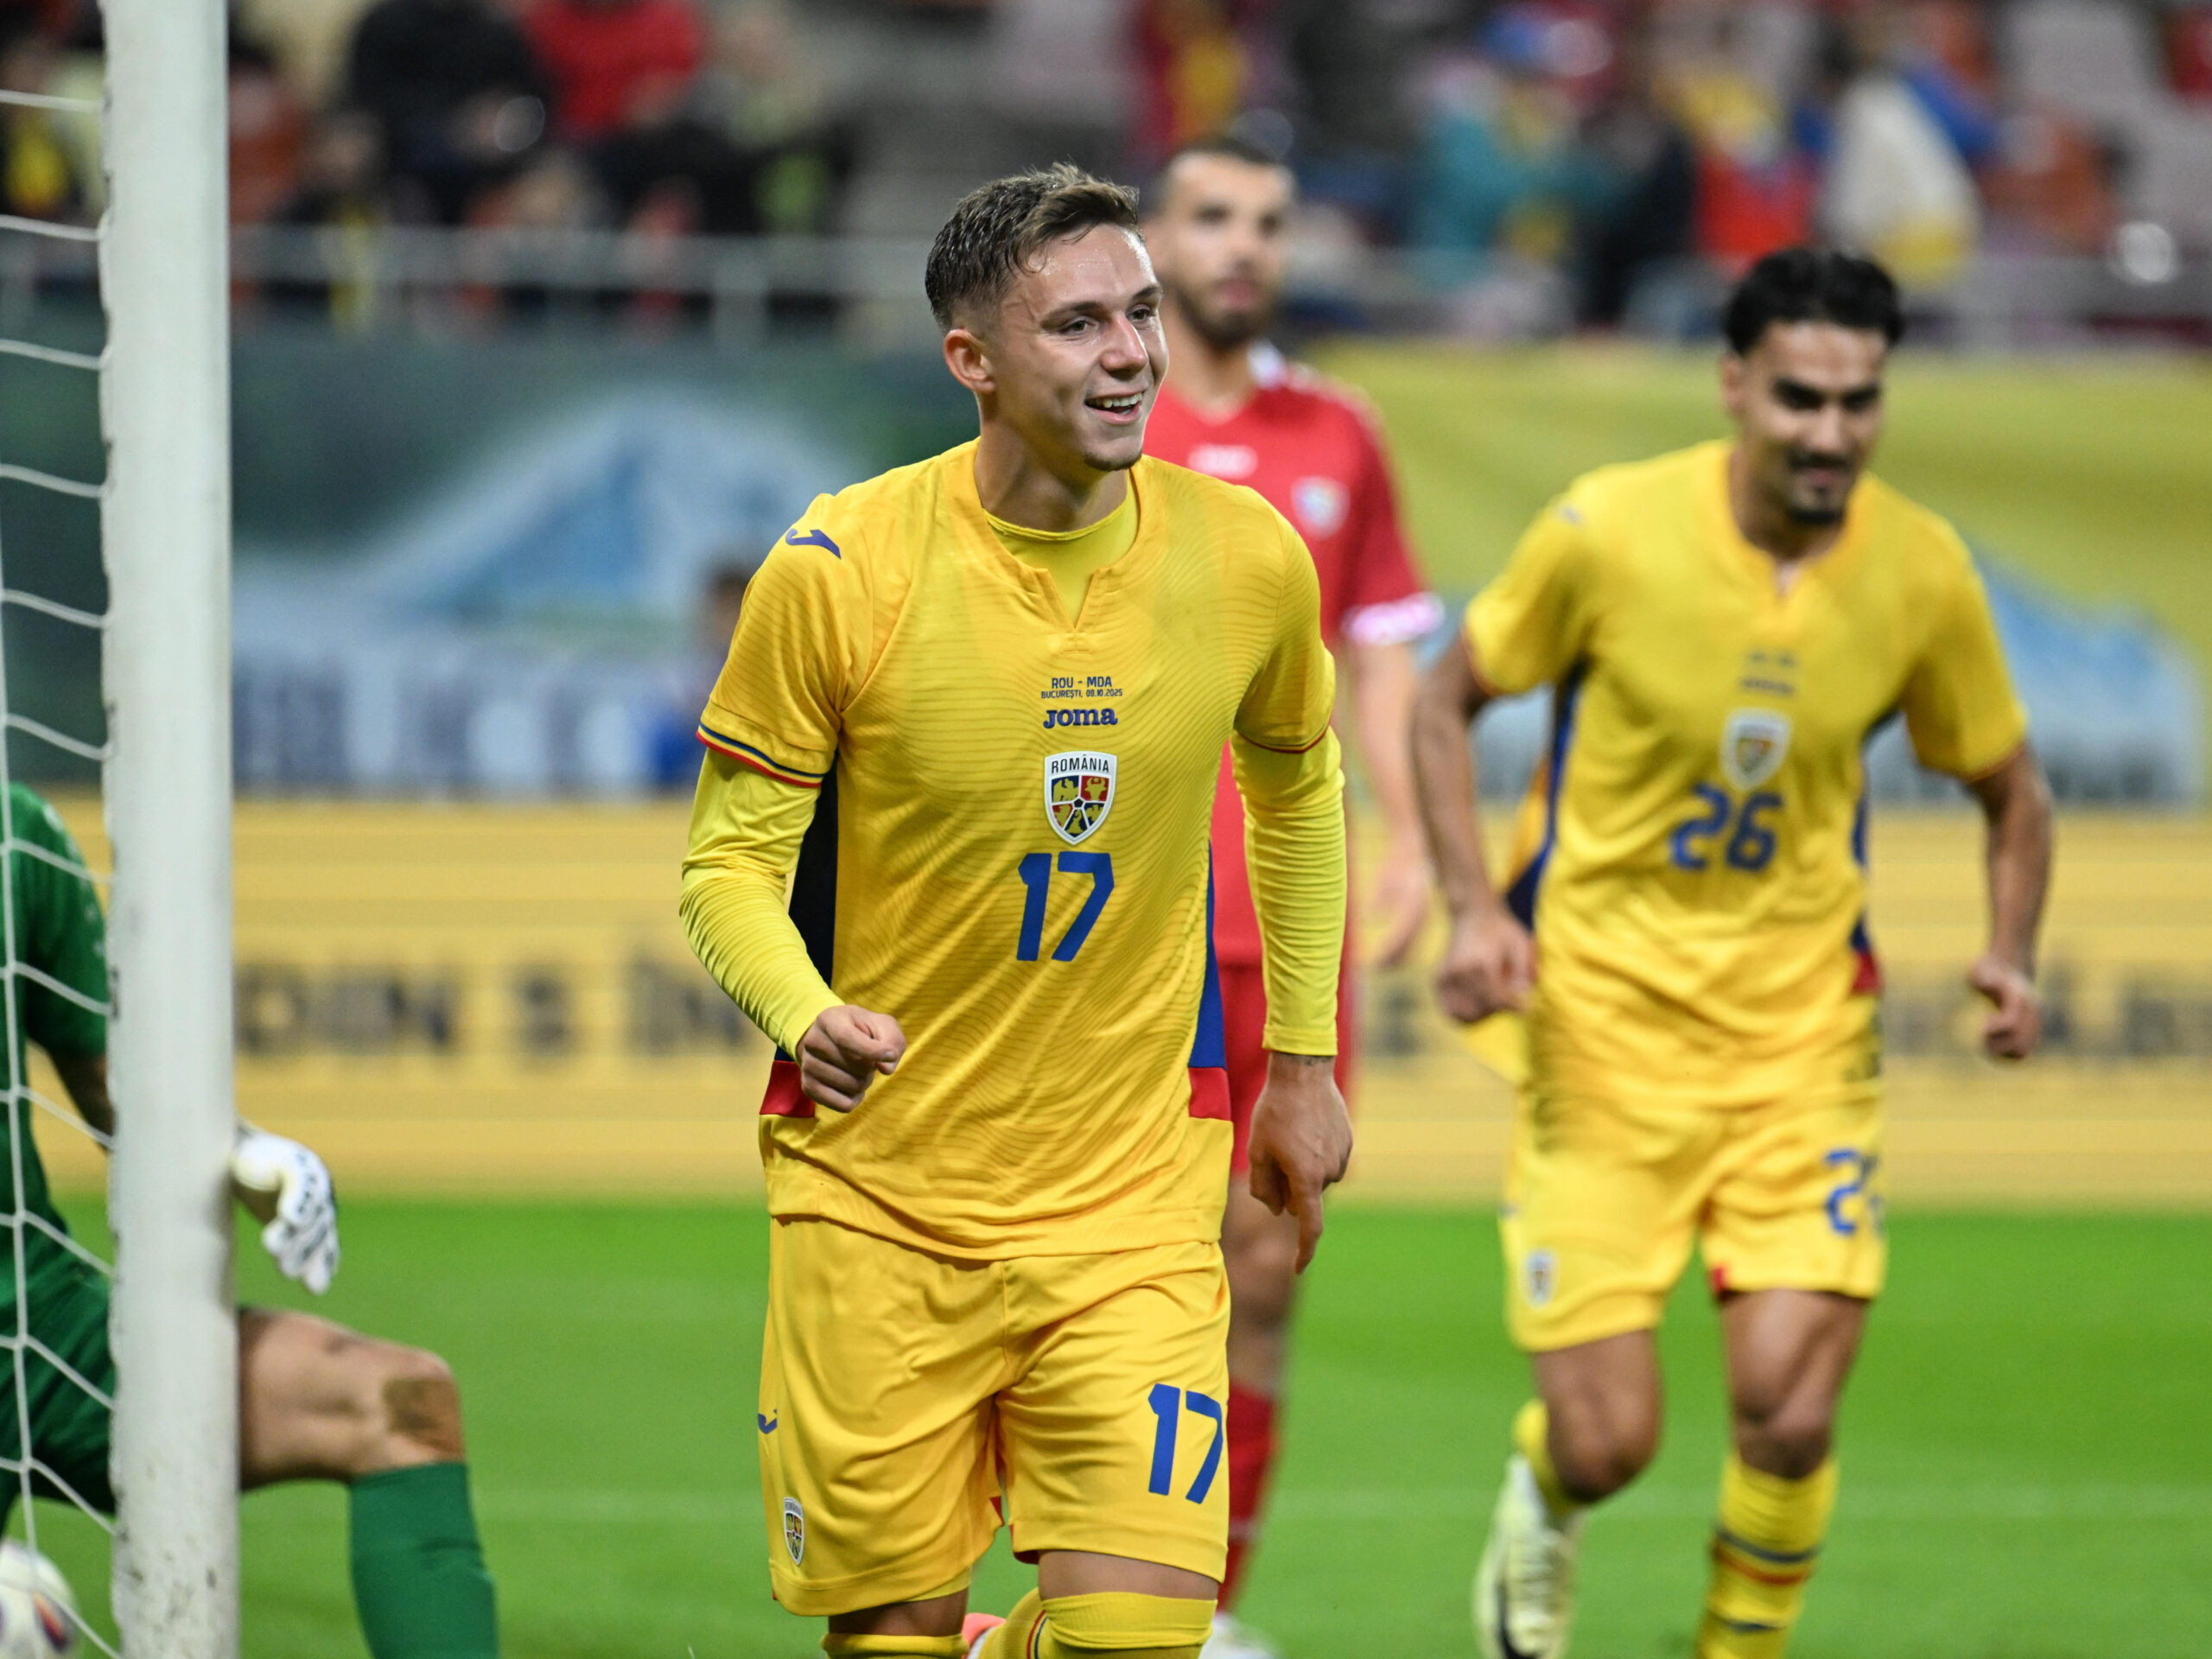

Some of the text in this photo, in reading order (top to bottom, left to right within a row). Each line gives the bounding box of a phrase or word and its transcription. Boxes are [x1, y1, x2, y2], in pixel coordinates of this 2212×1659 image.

[1052, 677, 1074, 689] ROU
[1087, 676, 1112, 688] MDA
[1051, 753, 1109, 774] ROMÂNIA
[1669, 781, 1783, 874] 26
[1016, 850, 1115, 962] 17
[1147, 1382, 1224, 1505] 17
